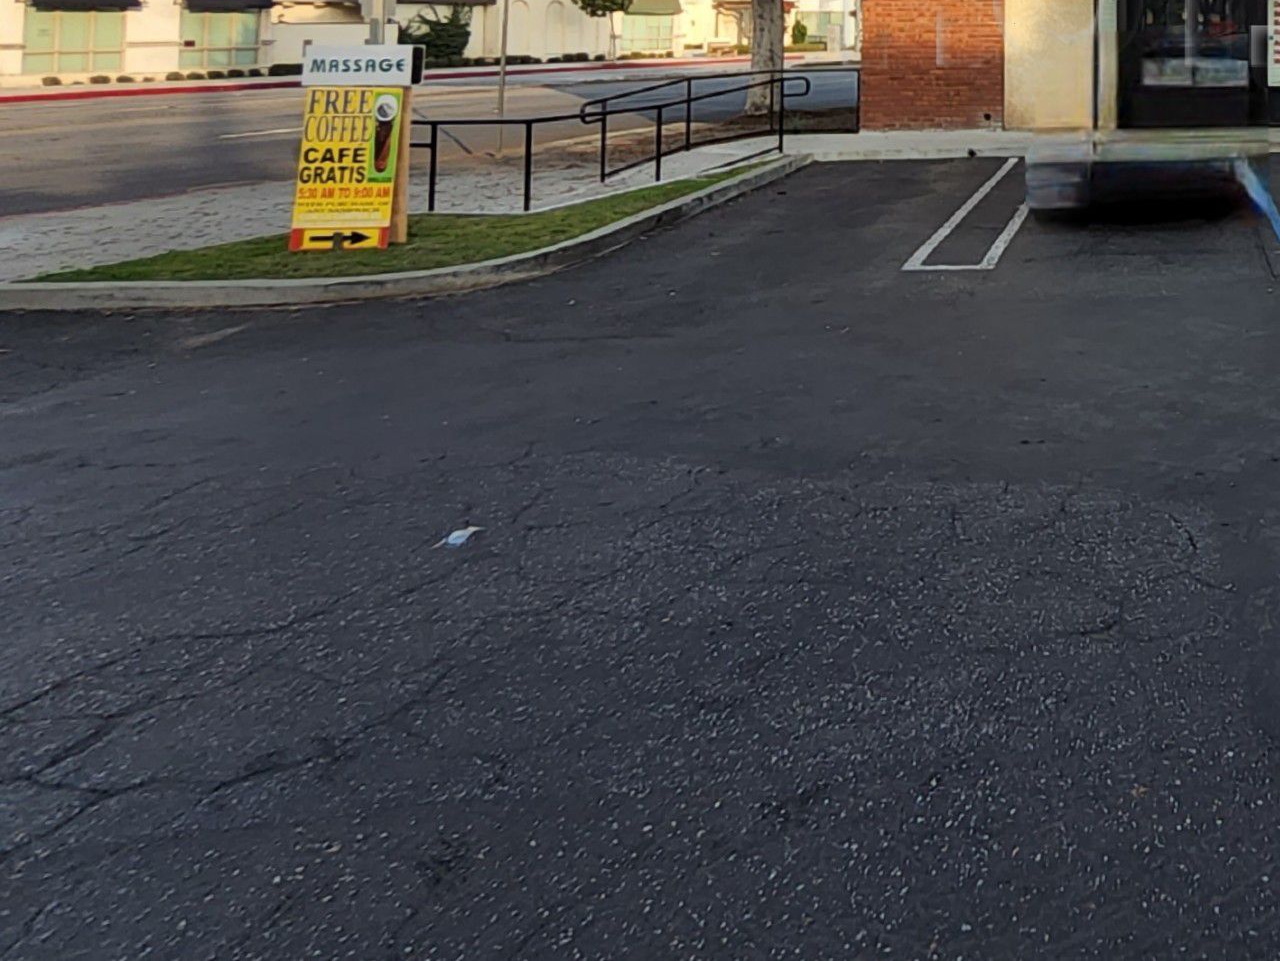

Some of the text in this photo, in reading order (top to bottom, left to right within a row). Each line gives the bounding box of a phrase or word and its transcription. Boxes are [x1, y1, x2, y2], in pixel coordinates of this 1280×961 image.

[309, 58, 406, 73] MASSAGE
[307, 89, 374, 115] FREE
[304, 115, 373, 143] COFFEE
[299, 166, 366, 184] GRATIS
[376, 186, 391, 198] AM
